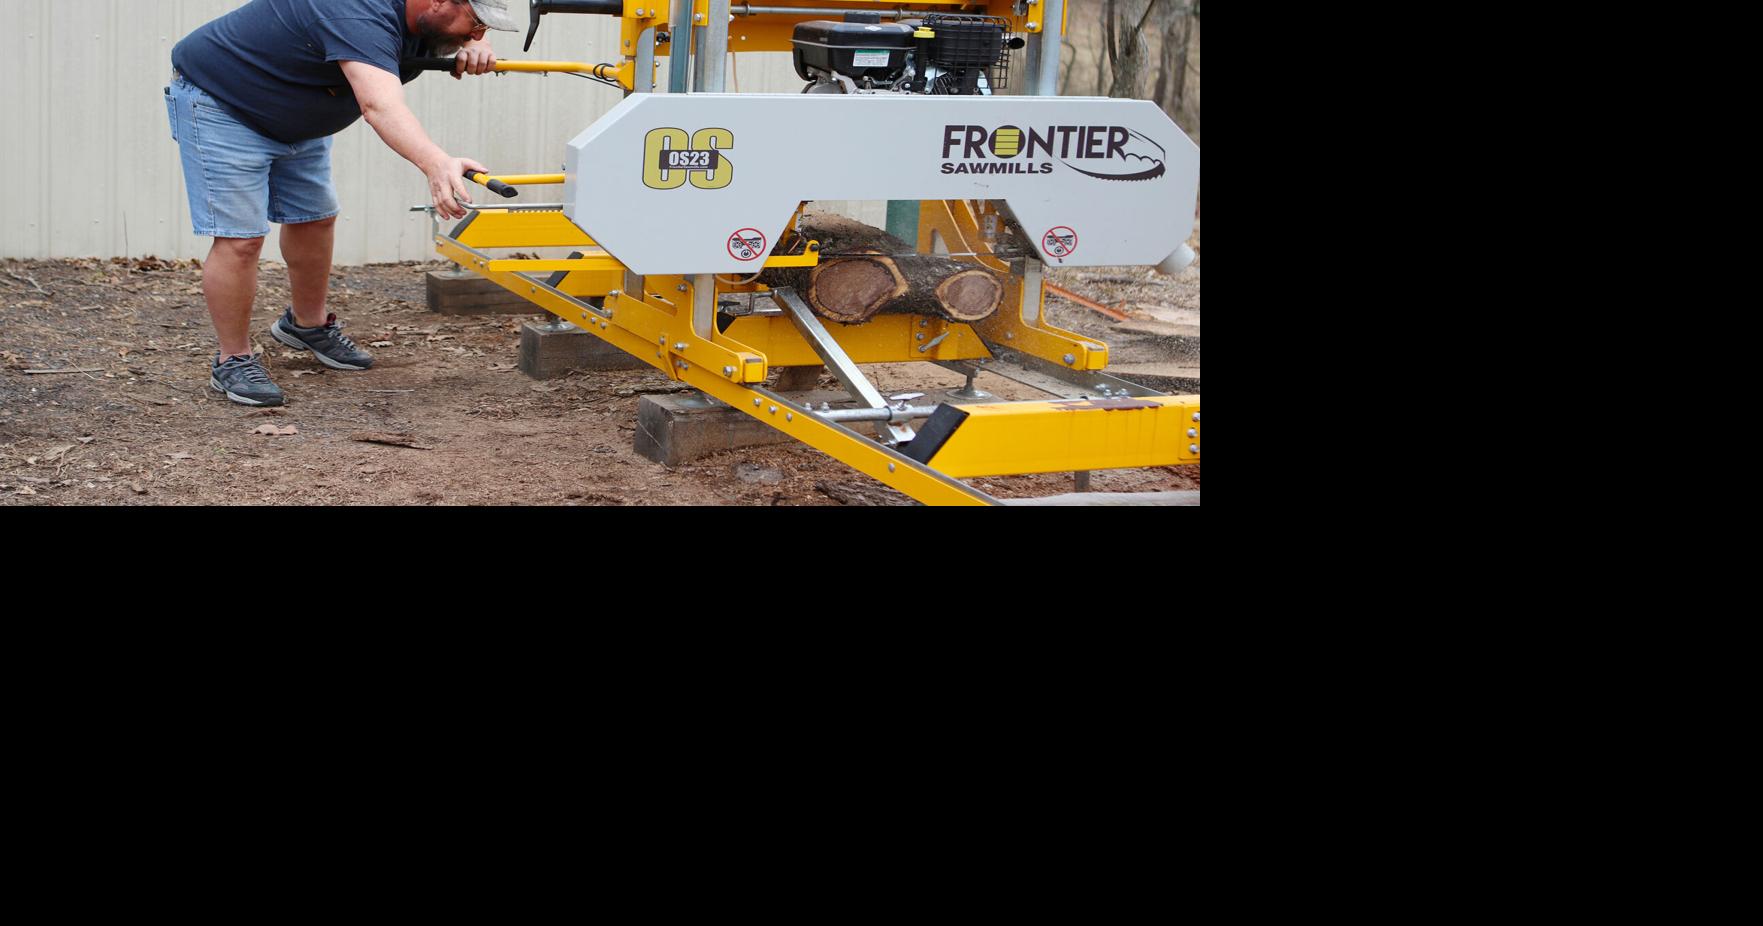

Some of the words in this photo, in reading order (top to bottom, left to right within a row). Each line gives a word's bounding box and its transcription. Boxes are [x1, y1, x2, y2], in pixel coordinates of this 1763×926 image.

[942, 125, 1130, 159] FRONTIER
[668, 151, 710, 166] OS23
[940, 162, 1053, 174] SAWMILLS
